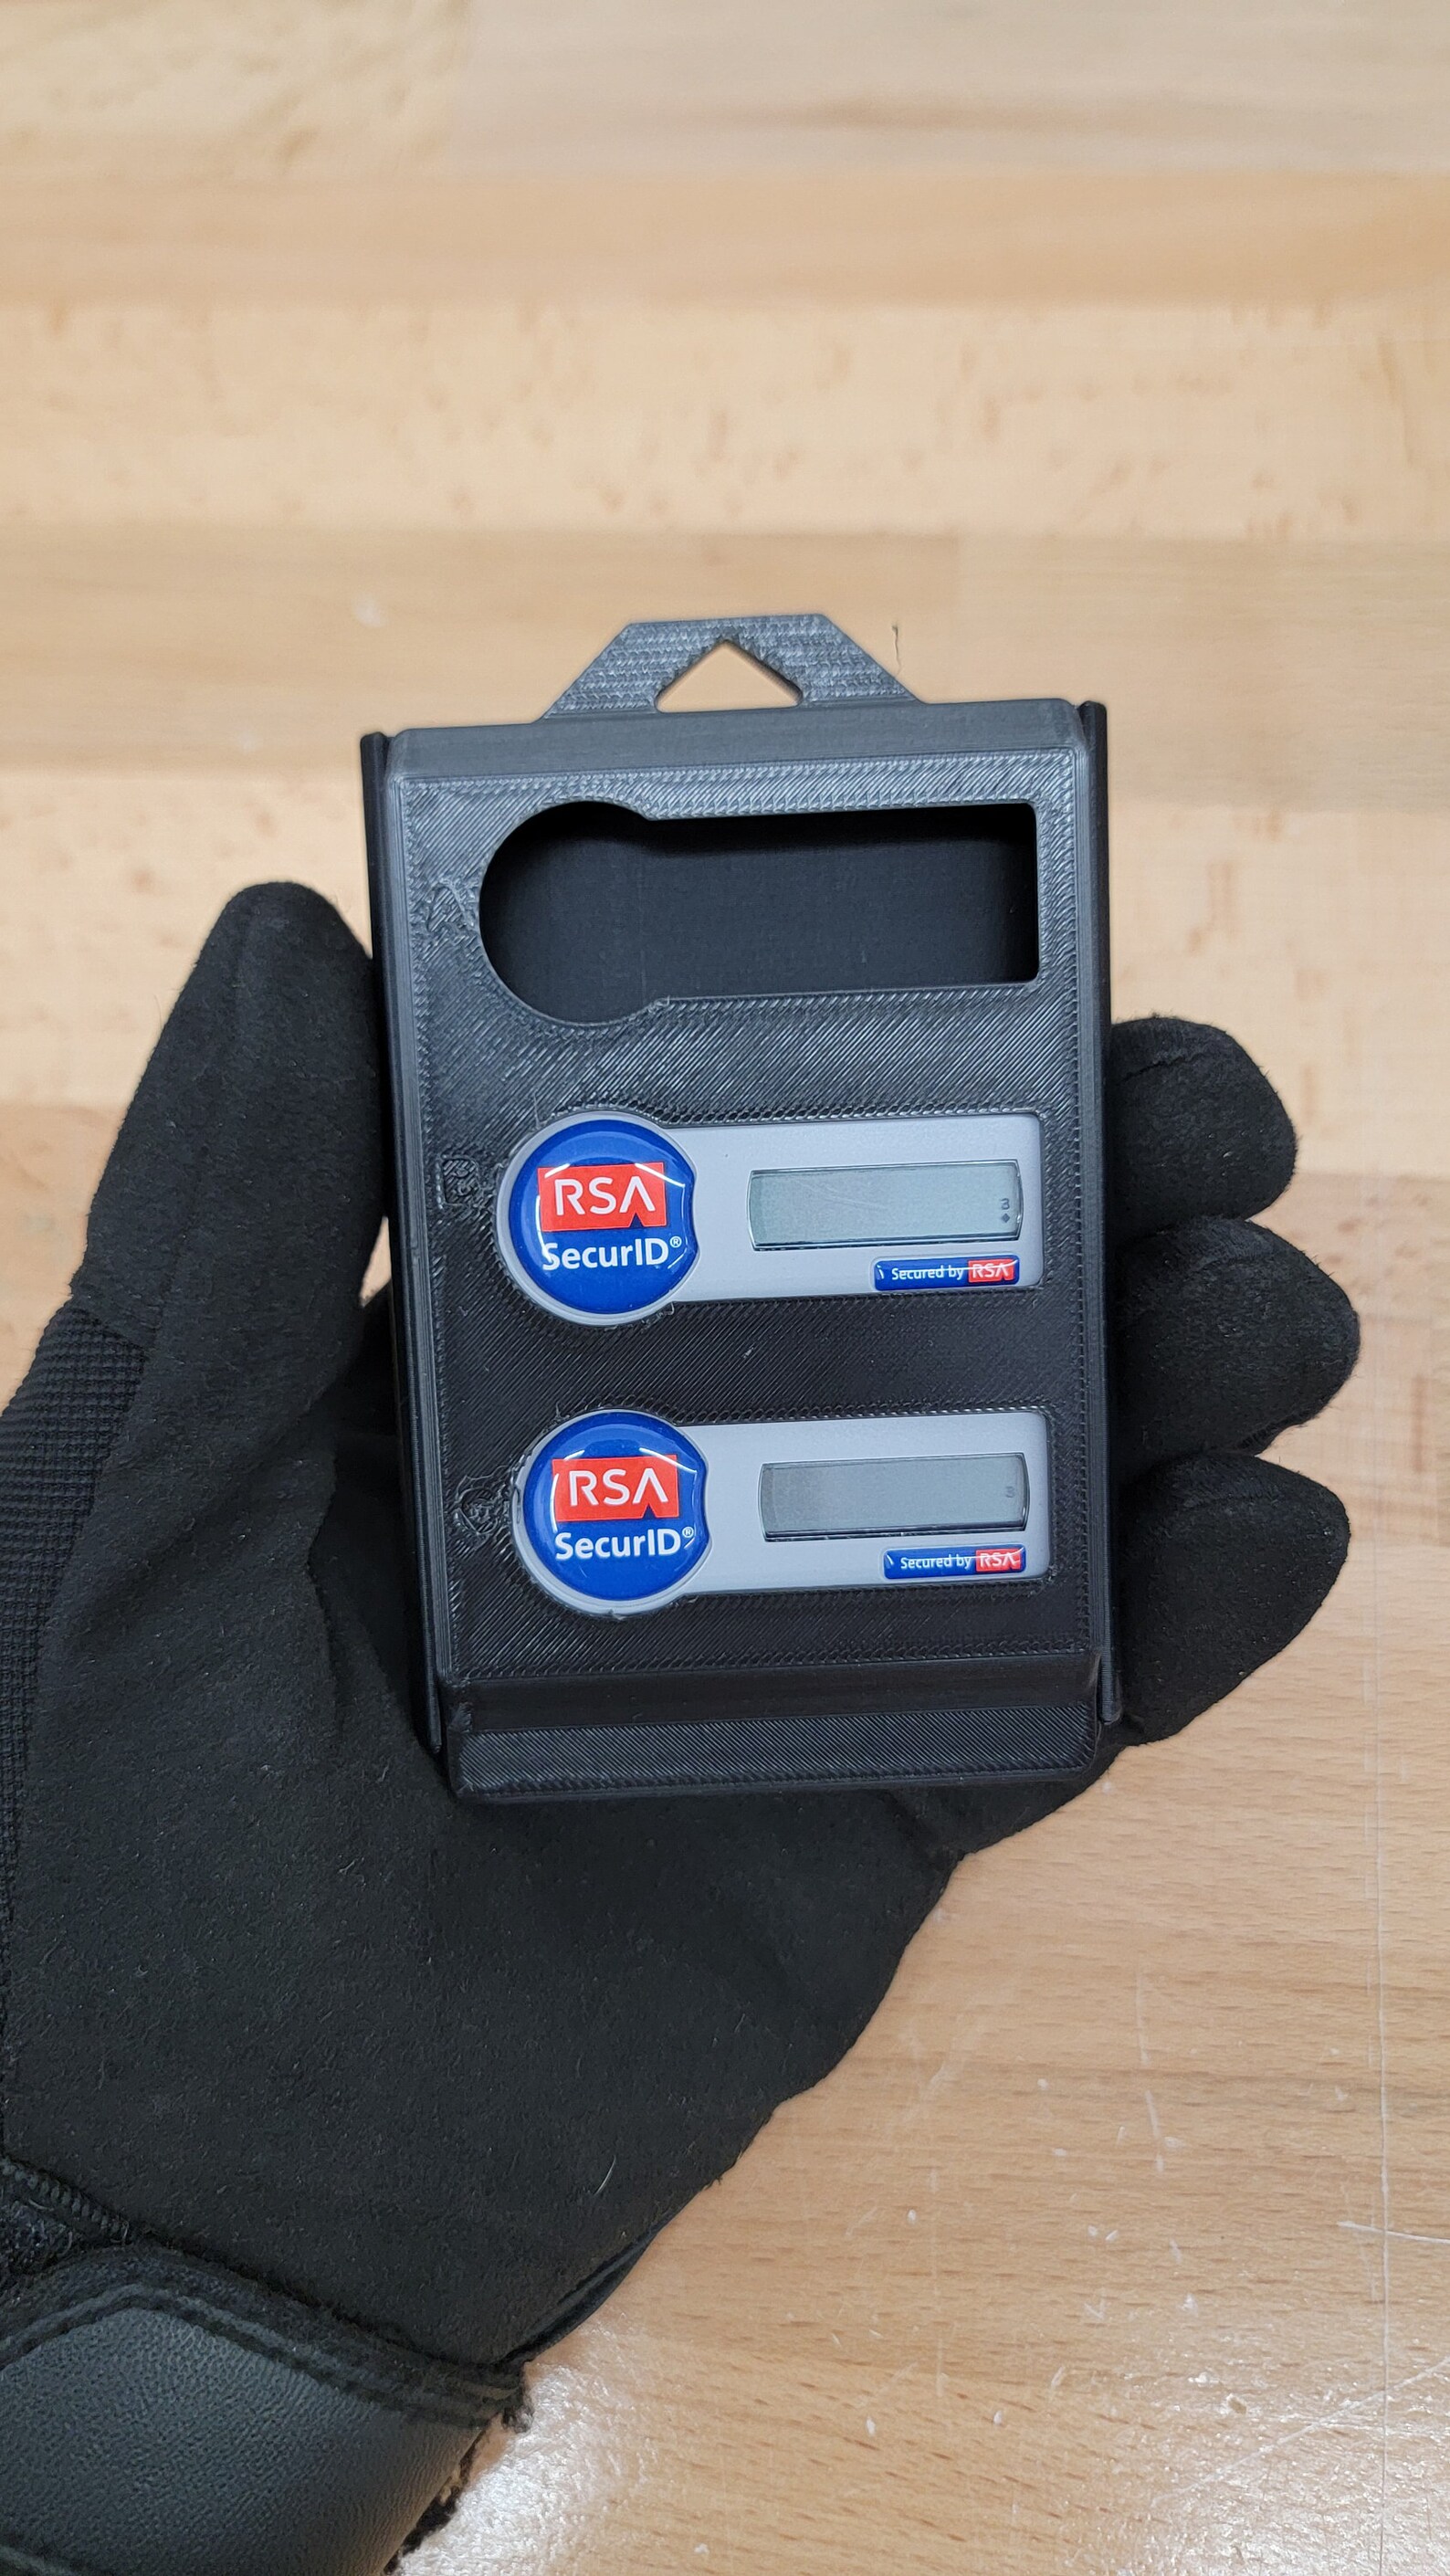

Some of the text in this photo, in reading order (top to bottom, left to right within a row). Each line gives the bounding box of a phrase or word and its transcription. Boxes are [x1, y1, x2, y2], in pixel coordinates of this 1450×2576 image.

[554, 1176, 656, 1215] RSA
[1001, 1198, 1010, 1210] 3
[891, 1262, 1009, 1280] Secured by RSA
[569, 1468, 668, 1507] RSA
[900, 1551, 1016, 1570] Secured by RSA
